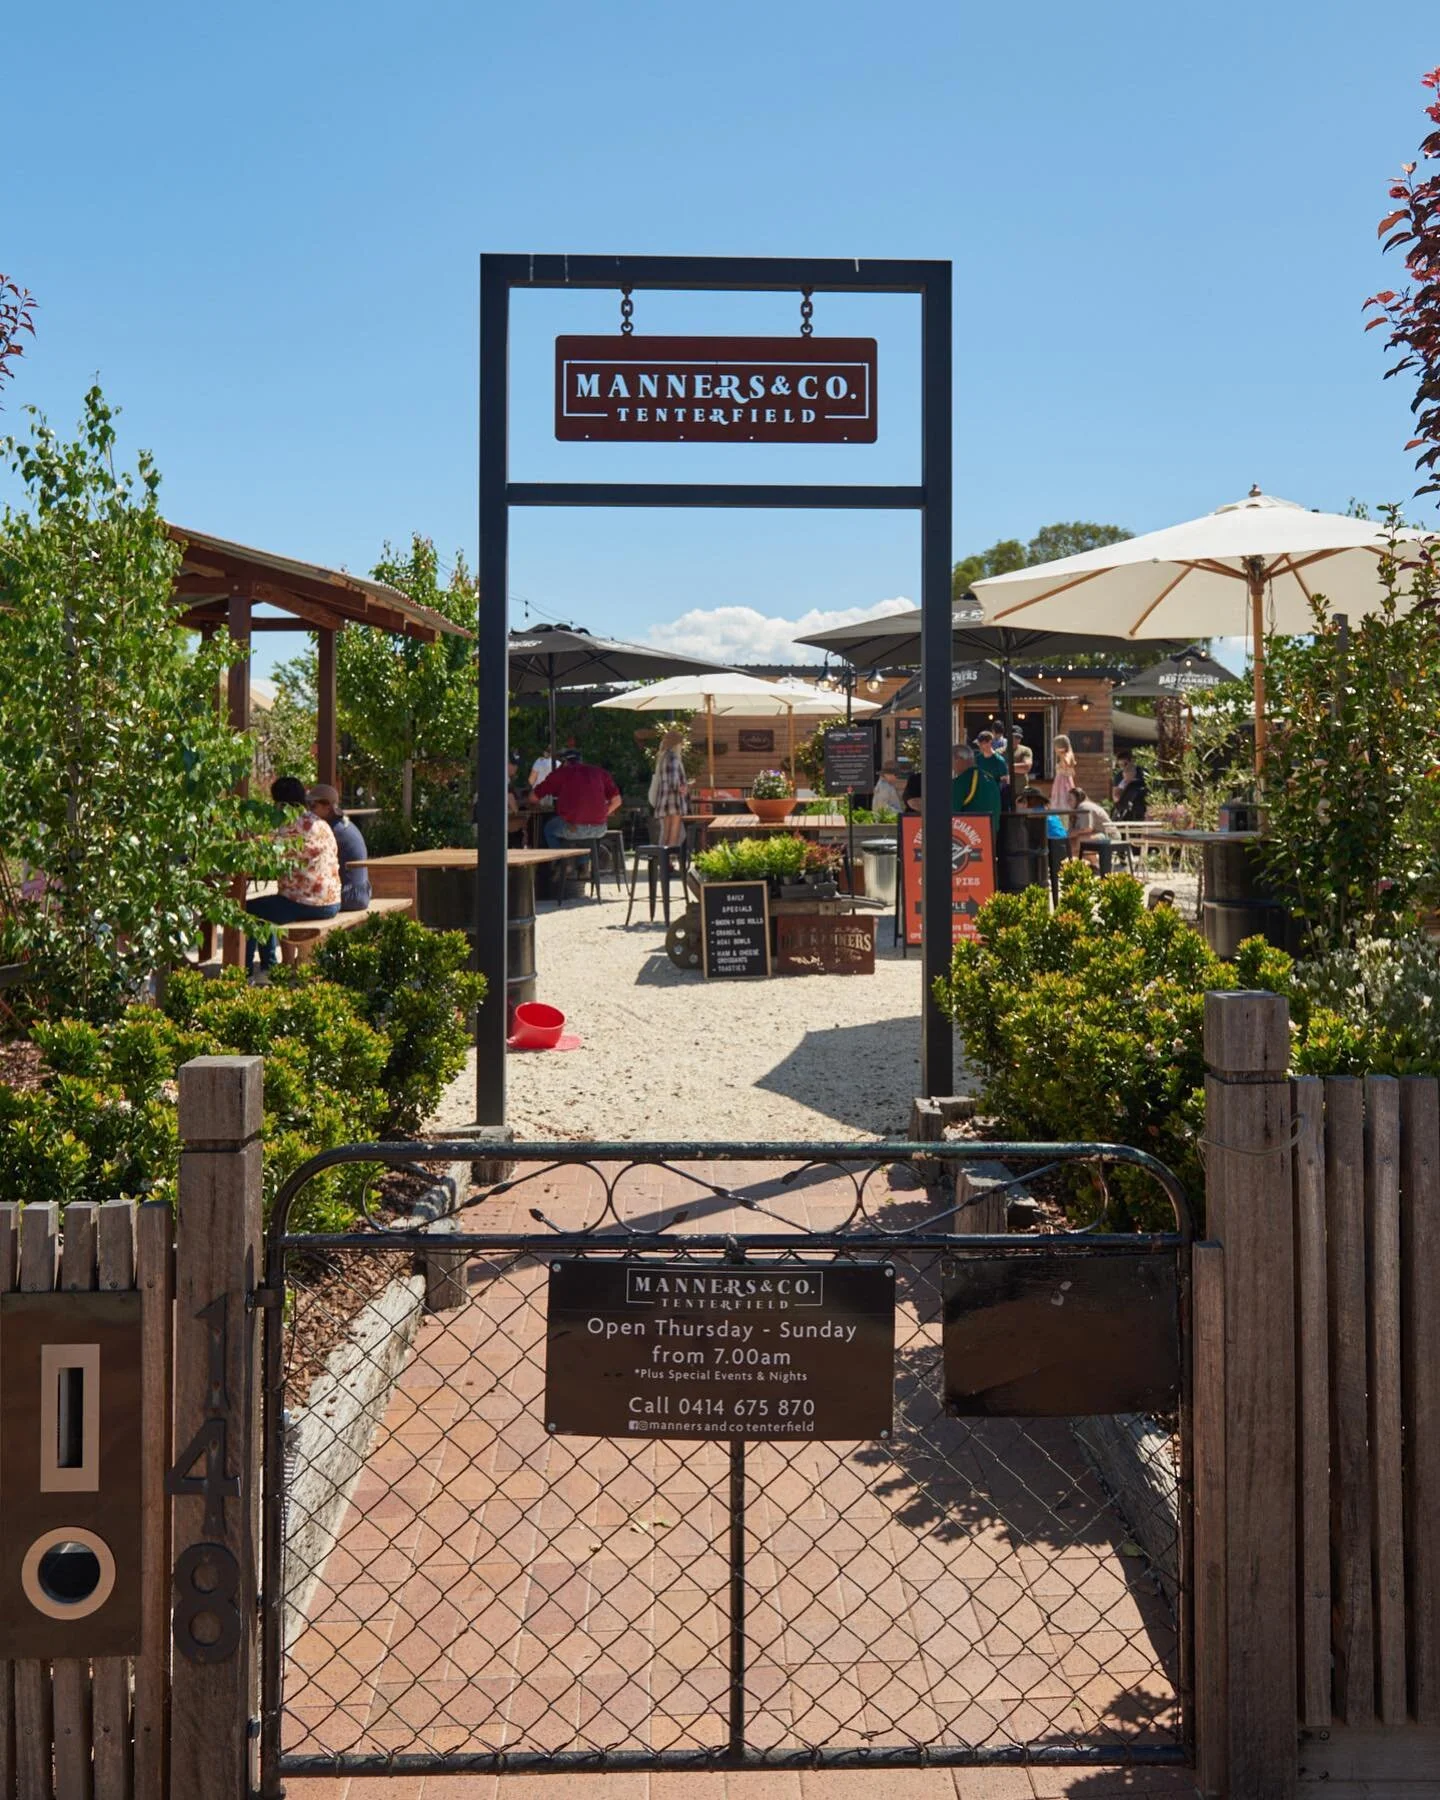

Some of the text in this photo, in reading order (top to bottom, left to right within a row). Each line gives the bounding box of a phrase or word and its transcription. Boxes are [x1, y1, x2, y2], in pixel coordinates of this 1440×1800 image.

[575, 373, 857, 404] MANNERS&CO.
[617, 407, 816, 426] TENTERFIELD
[635, 1276, 816, 1298] MANNERS&CO.
[661, 1298, 789, 1311] TENTERFIELD
[587, 1317, 646, 1340] Open
[655, 1319, 754, 1342] Thursday
[780, 1321, 857, 1343] Sunday
[652, 1345, 792, 1366] from 7.00am
[668, 1368, 711, 1382] Special
[715, 1369, 753, 1382] Events
[756, 1370, 765, 1381] &
[769, 1370, 808, 1384] Nights
[628, 1396, 816, 1417] Call 0414 675 870
